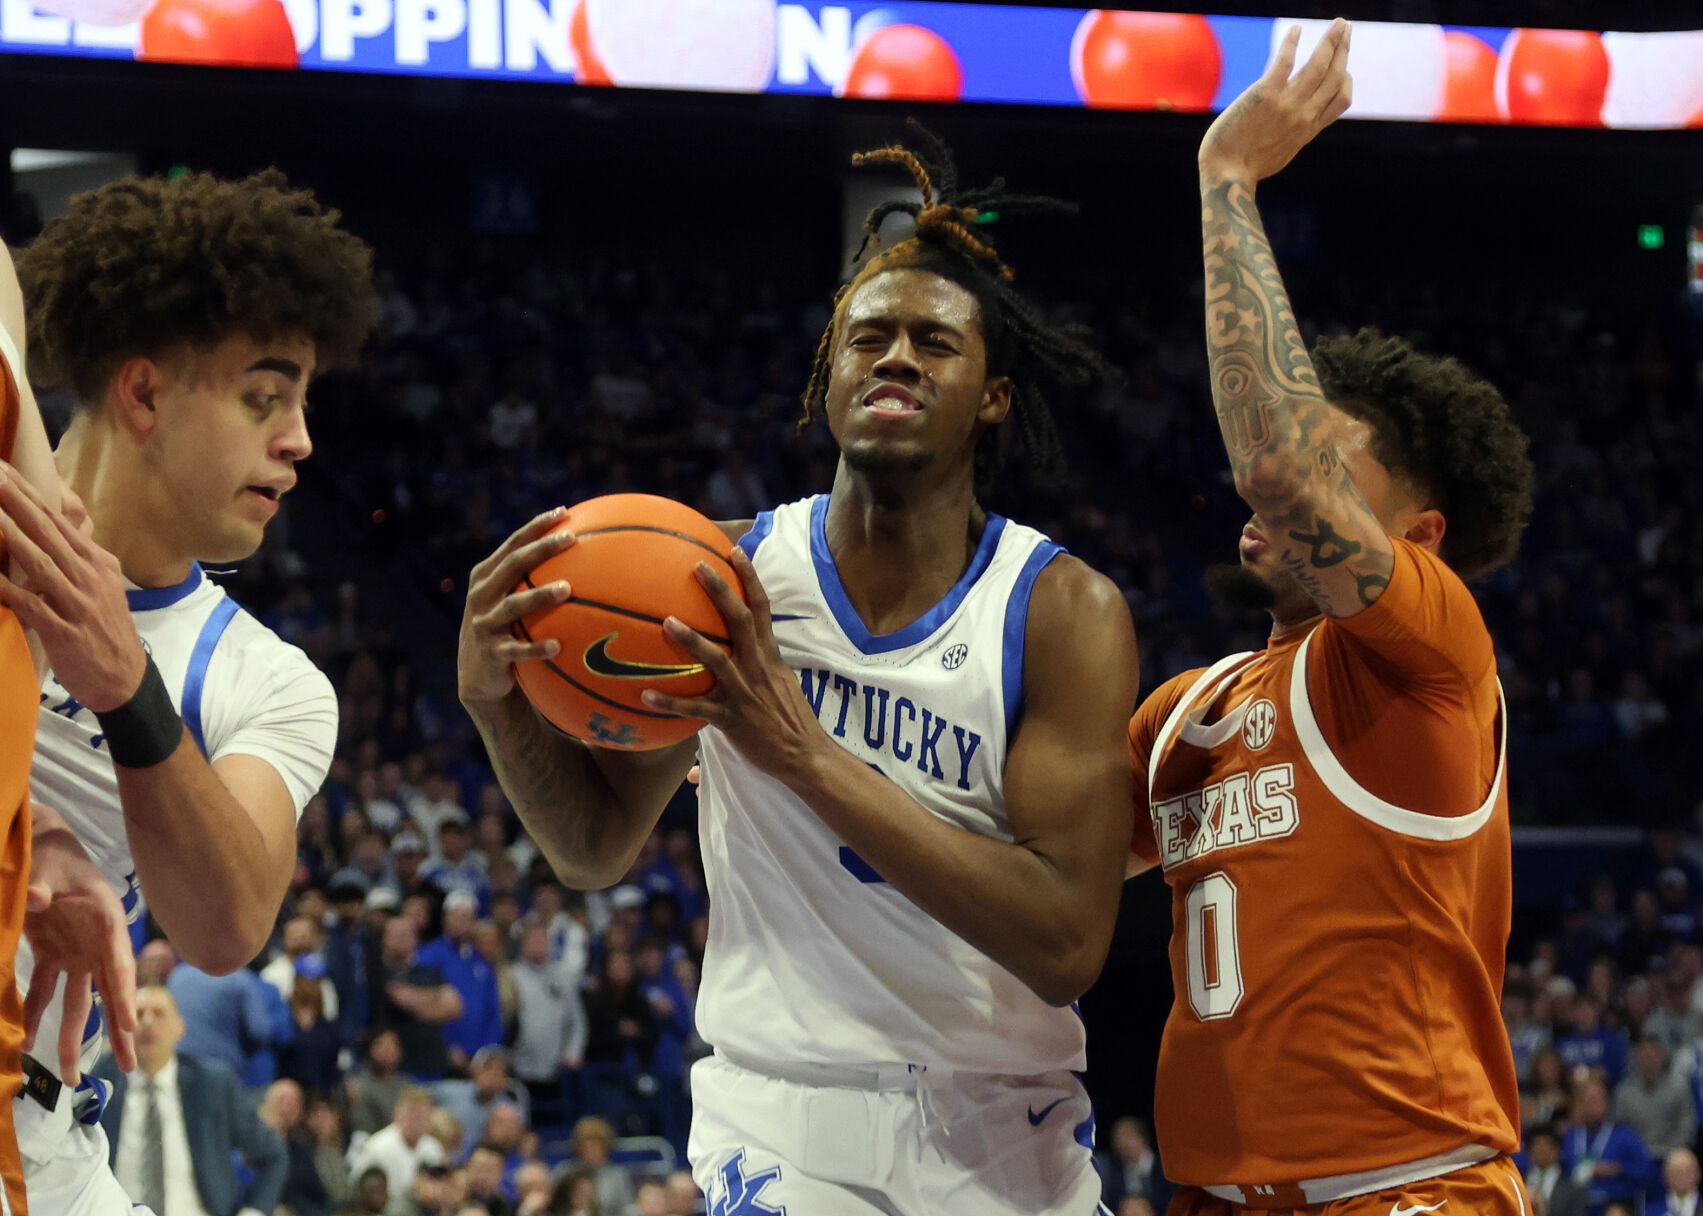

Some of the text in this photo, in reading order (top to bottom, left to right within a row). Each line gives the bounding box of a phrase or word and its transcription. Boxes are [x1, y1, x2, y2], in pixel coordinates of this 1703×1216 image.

[942, 644, 968, 670] SEC
[800, 667, 981, 791] NTUCKY
[1243, 699, 1277, 751] SEC
[1151, 763, 1301, 872] EXAS
[1185, 871, 1245, 1022] 0
